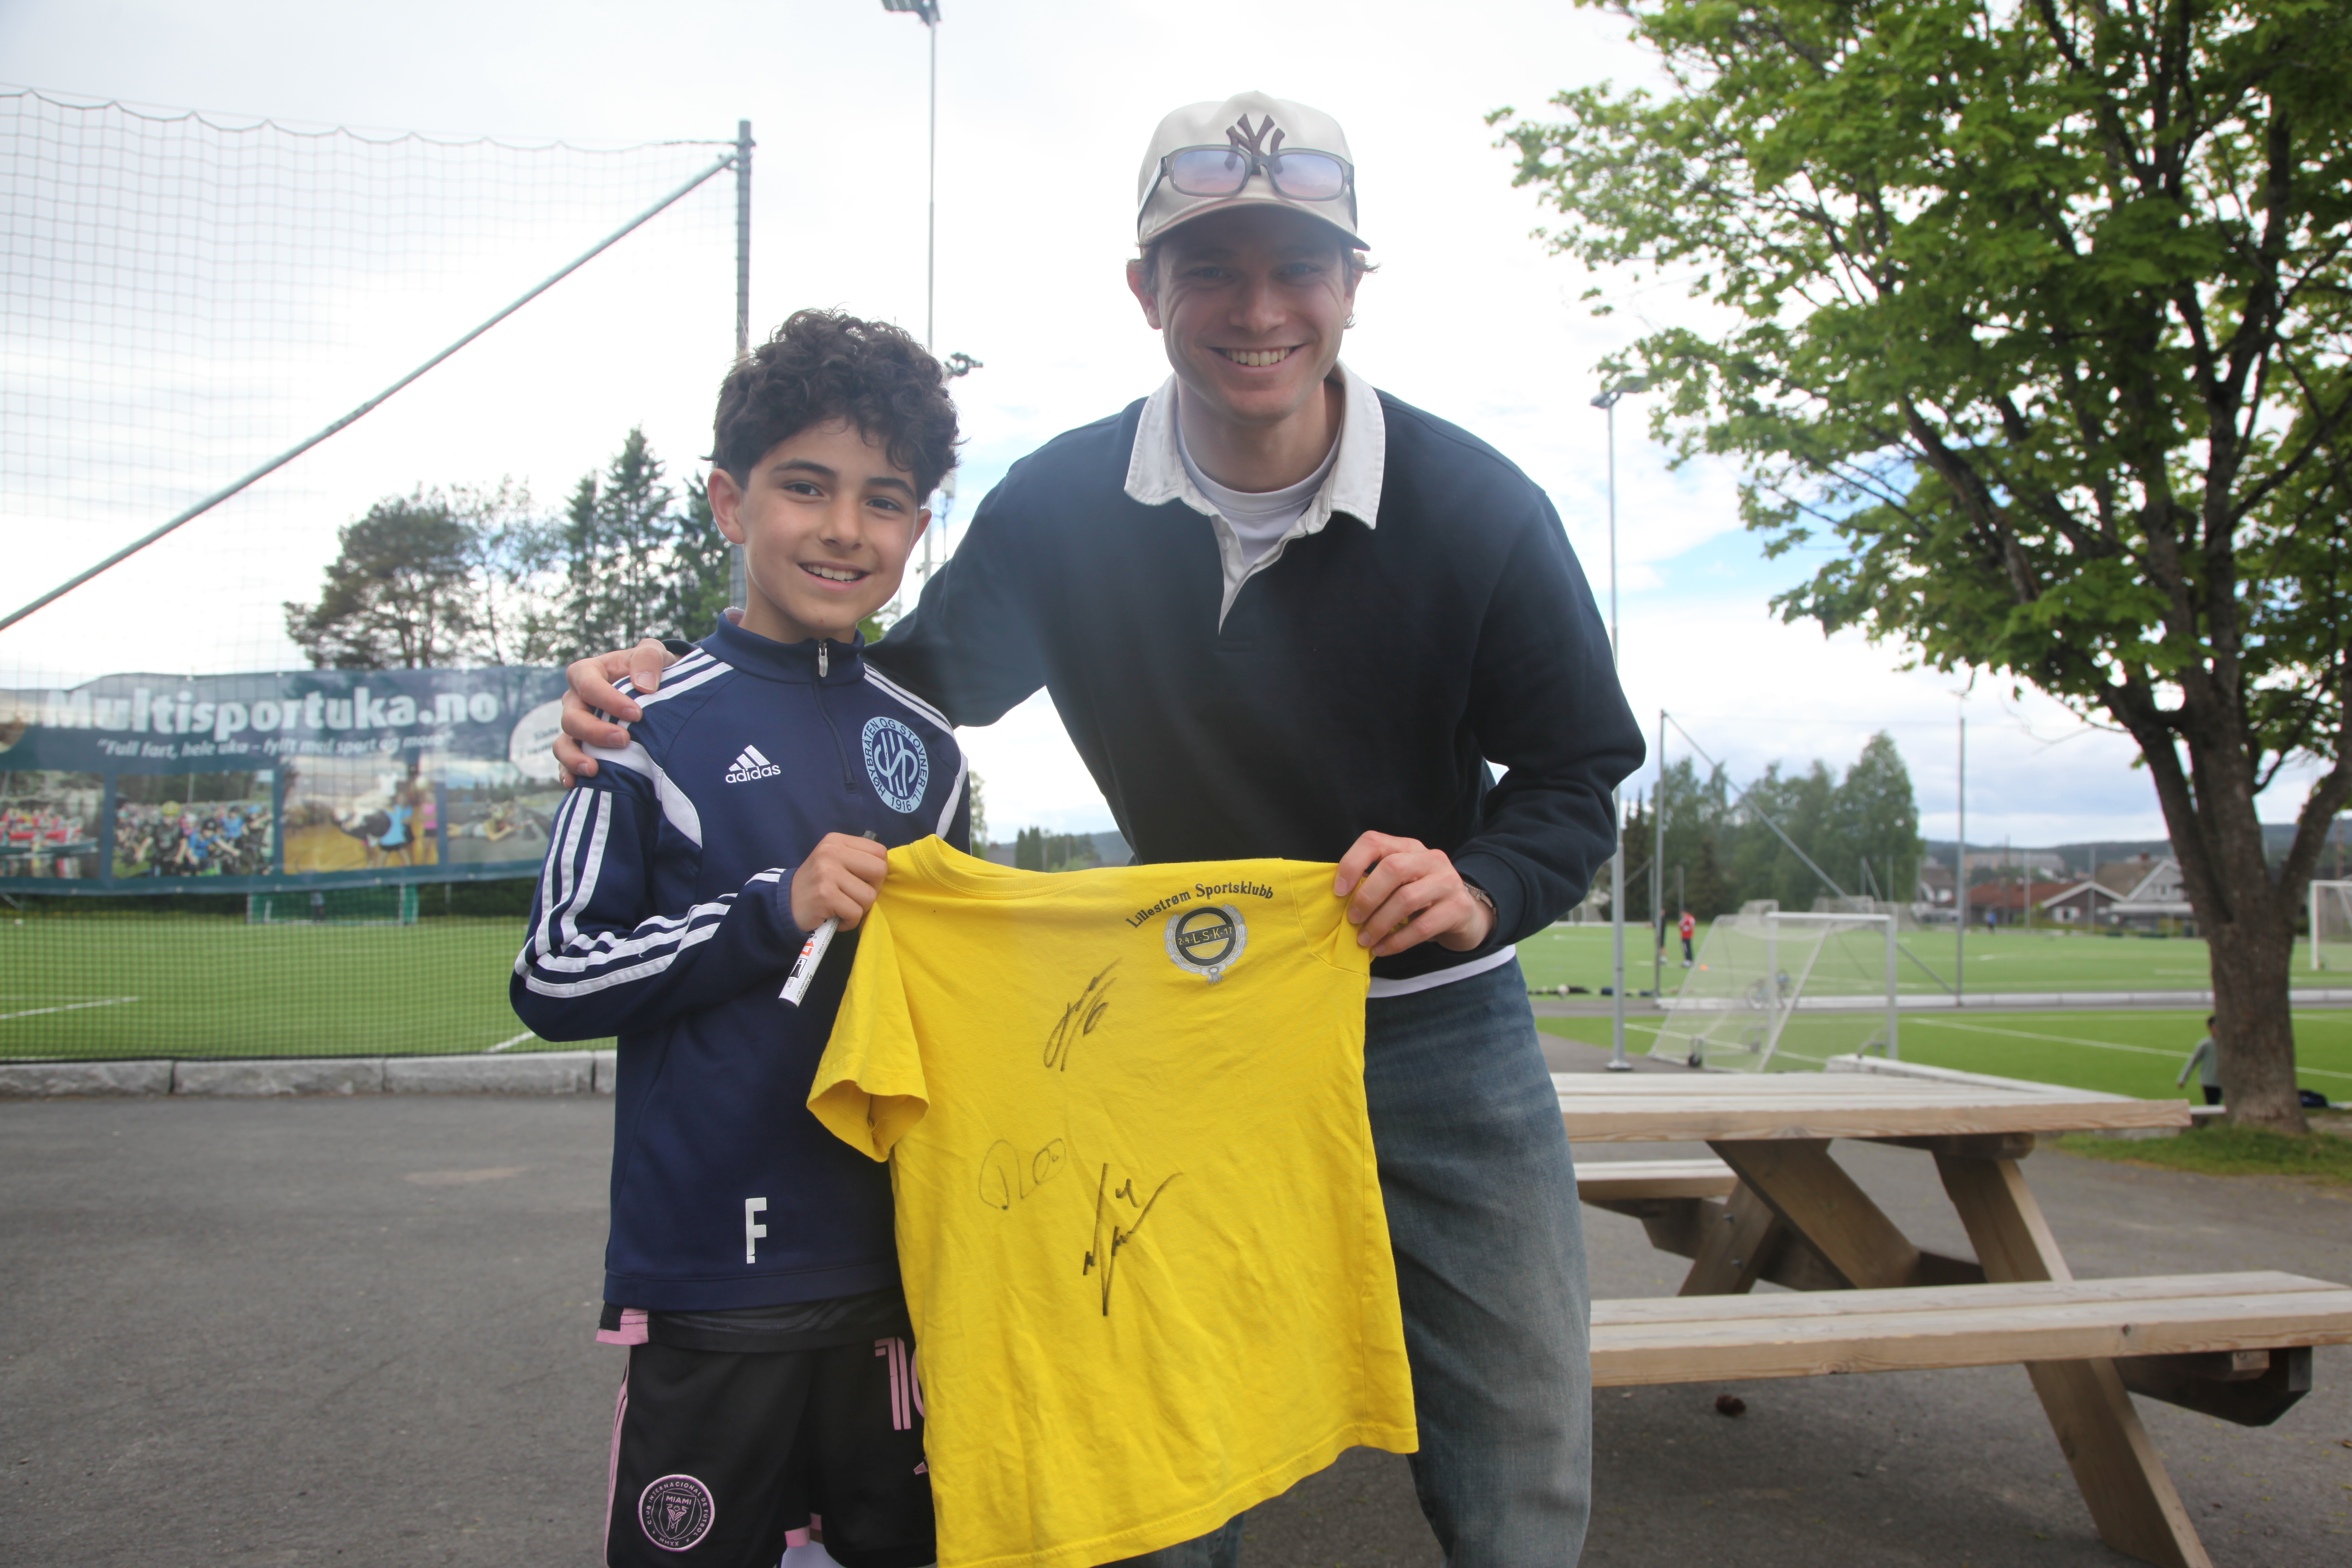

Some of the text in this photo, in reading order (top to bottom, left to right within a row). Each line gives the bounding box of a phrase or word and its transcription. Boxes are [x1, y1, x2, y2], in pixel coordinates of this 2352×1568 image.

[41, 687, 499, 742] Multisportuka.no
[181, 740, 215, 757] hele
[217, 739, 249, 754] uka
[299, 738, 334, 753] med
[335, 738, 376, 756] sport
[379, 738, 400, 755] og
[862, 720, 886, 797] HØYBRÅTEN
[880, 718, 896, 729] OG
[900, 725, 928, 788] STOVNER
[725, 765, 781, 783] adidas
[891, 797, 912, 812] 1916
[1126, 880, 1274, 928] Lillestrøm Sportsklubb
[745, 1197, 767, 1264] F
[648, 1481, 701, 1503] INTERNACIONAL
[665, 1496, 692, 1505] MIAMI
[701, 1497, 708, 1507] DE
[693, 1509, 709, 1536] FÚTBOL
[659, 1537, 679, 1547] MMXX
